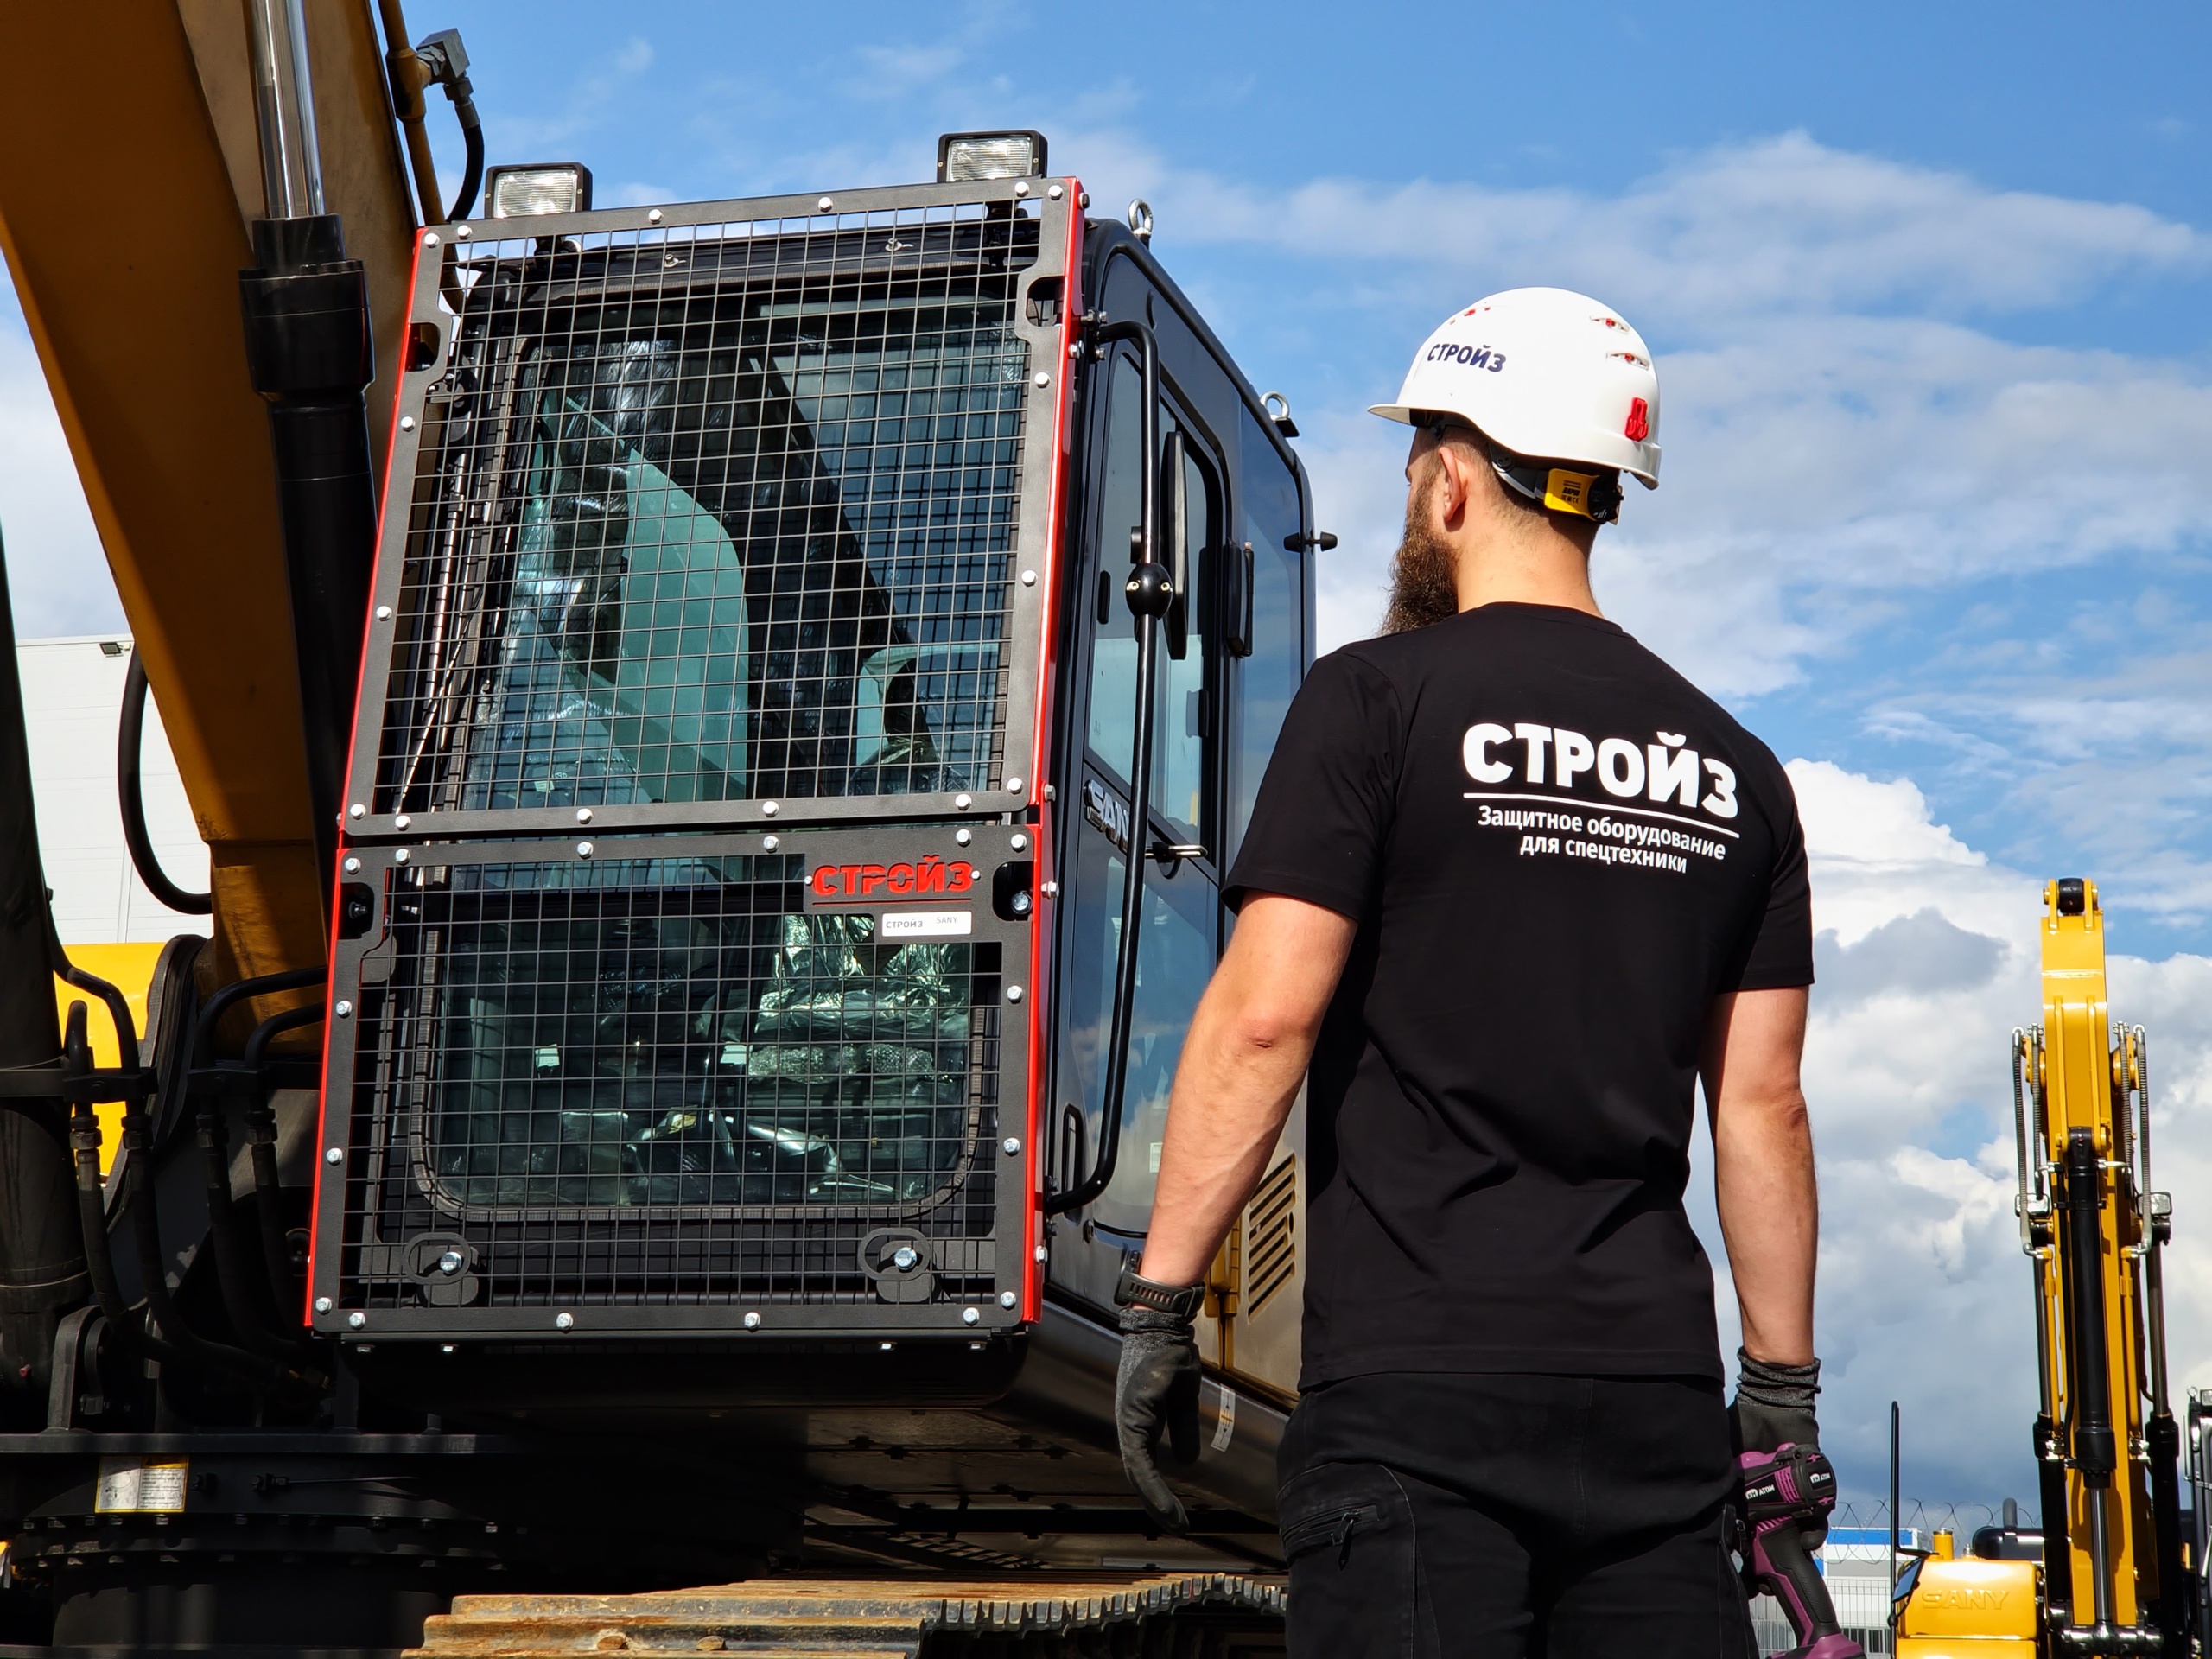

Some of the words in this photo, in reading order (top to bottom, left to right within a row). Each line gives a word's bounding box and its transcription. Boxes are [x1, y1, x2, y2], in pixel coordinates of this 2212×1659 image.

[1084, 779, 1130, 852] SAN
[1478, 804, 1583, 832] Защитное
[1586, 817, 1726, 860] оборудование
[1520, 836, 1559, 855] для
[1565, 836, 1687, 874] спецтехники
[936, 916, 958, 925] SANY
[1759, 1484, 1775, 1496] ATOM
[1922, 1589, 2009, 1609] SANY
